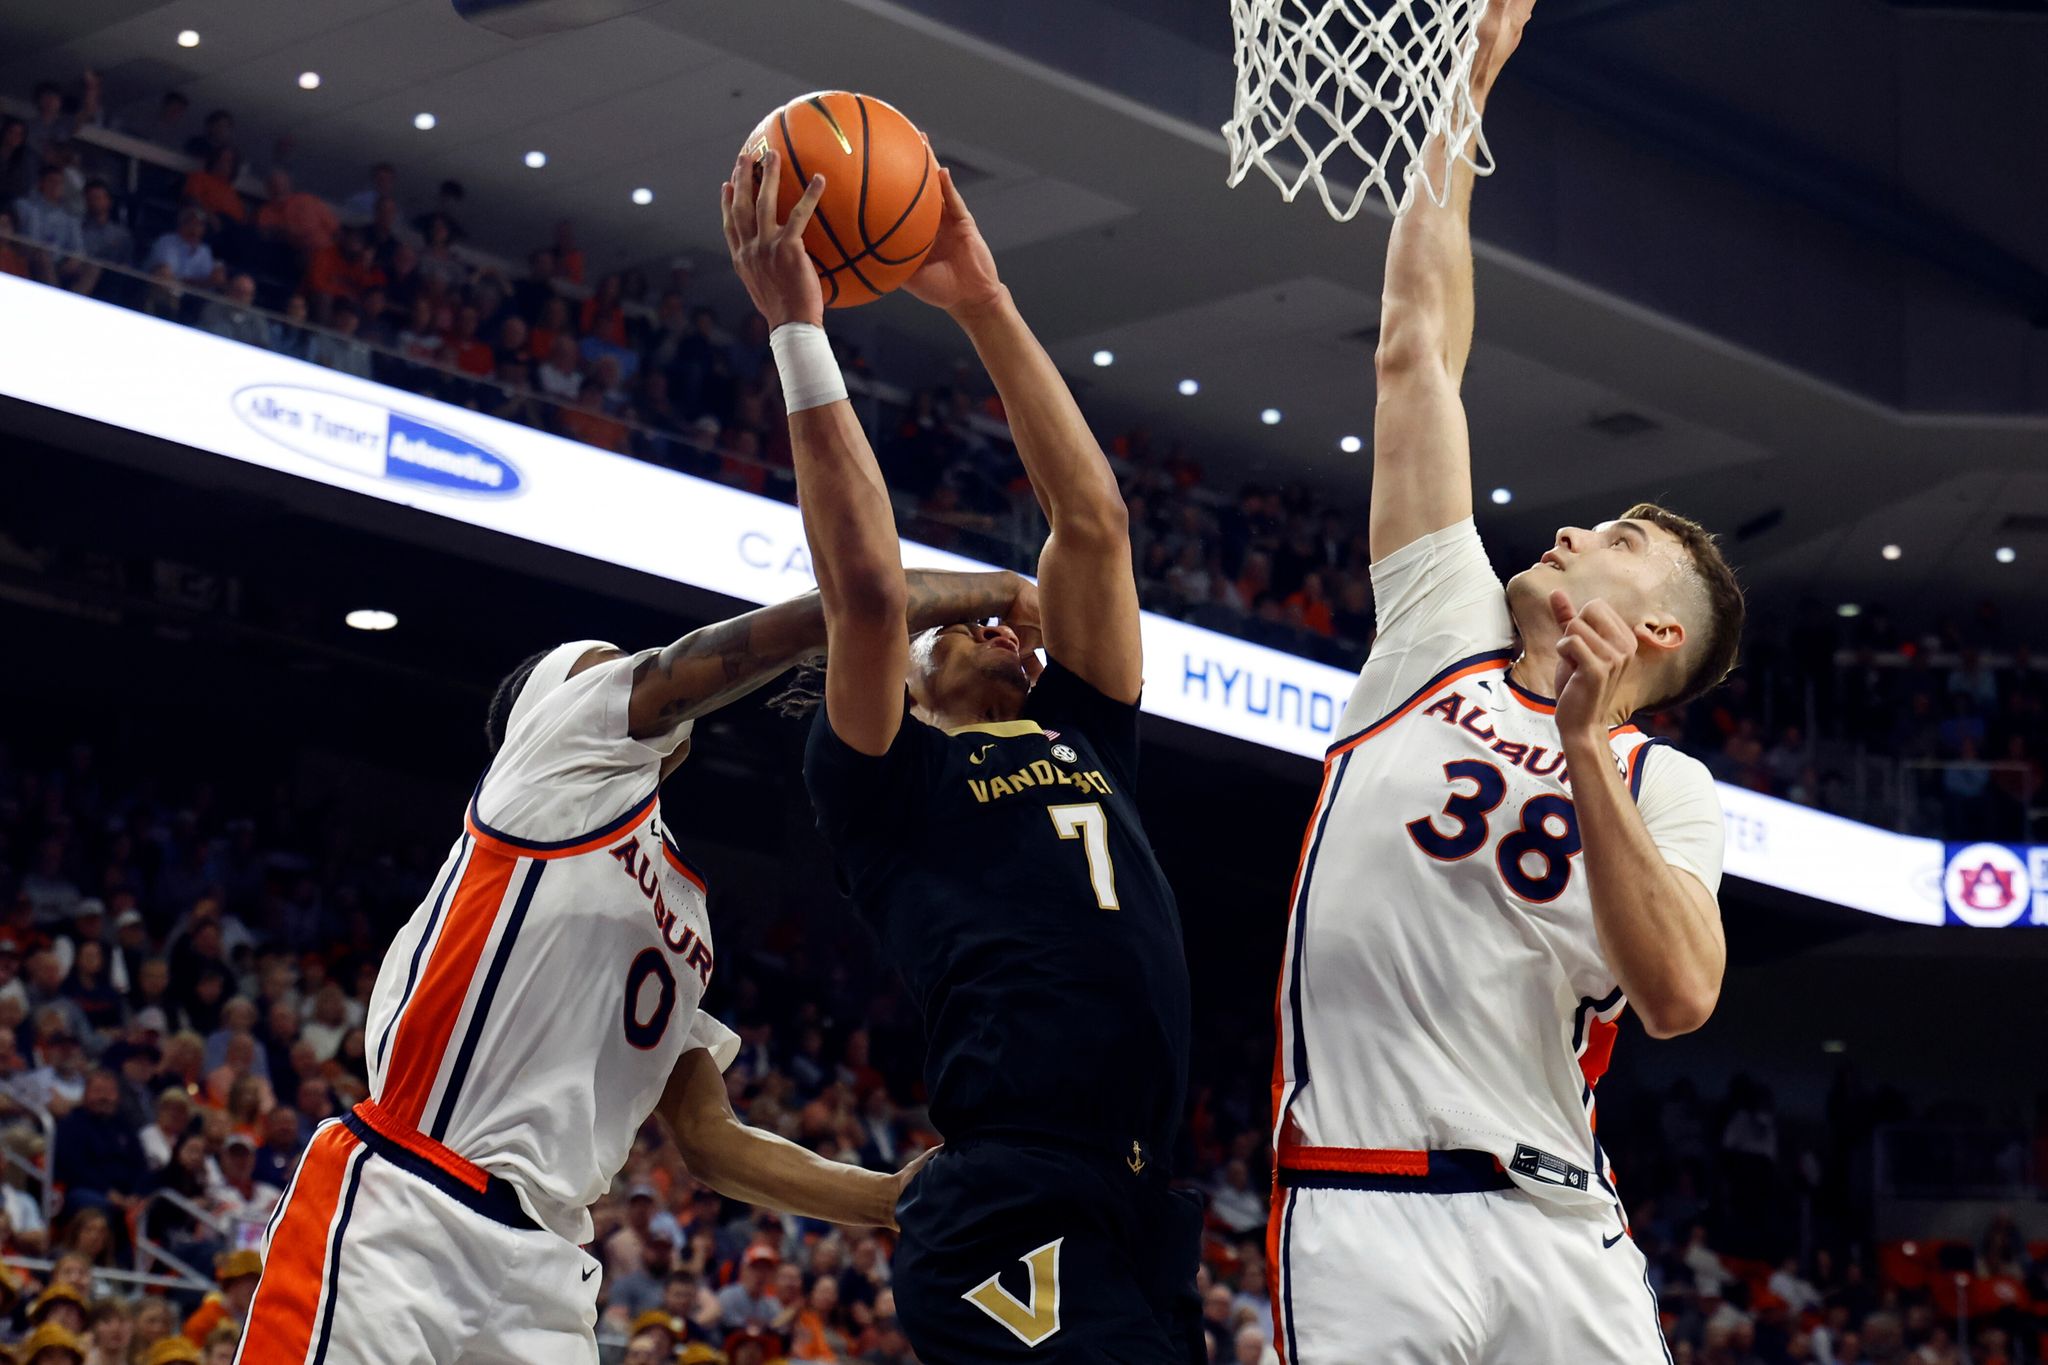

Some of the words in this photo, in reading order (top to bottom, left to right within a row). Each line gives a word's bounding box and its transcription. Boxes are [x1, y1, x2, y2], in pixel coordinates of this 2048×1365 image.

[1182, 653, 1347, 734] HYUND
[1422, 692, 1572, 784] AUBU
[1047, 802, 1120, 911] 7
[1405, 759, 1584, 904] 38
[623, 946, 676, 1051] 0
[961, 1236, 1065, 1349] V
